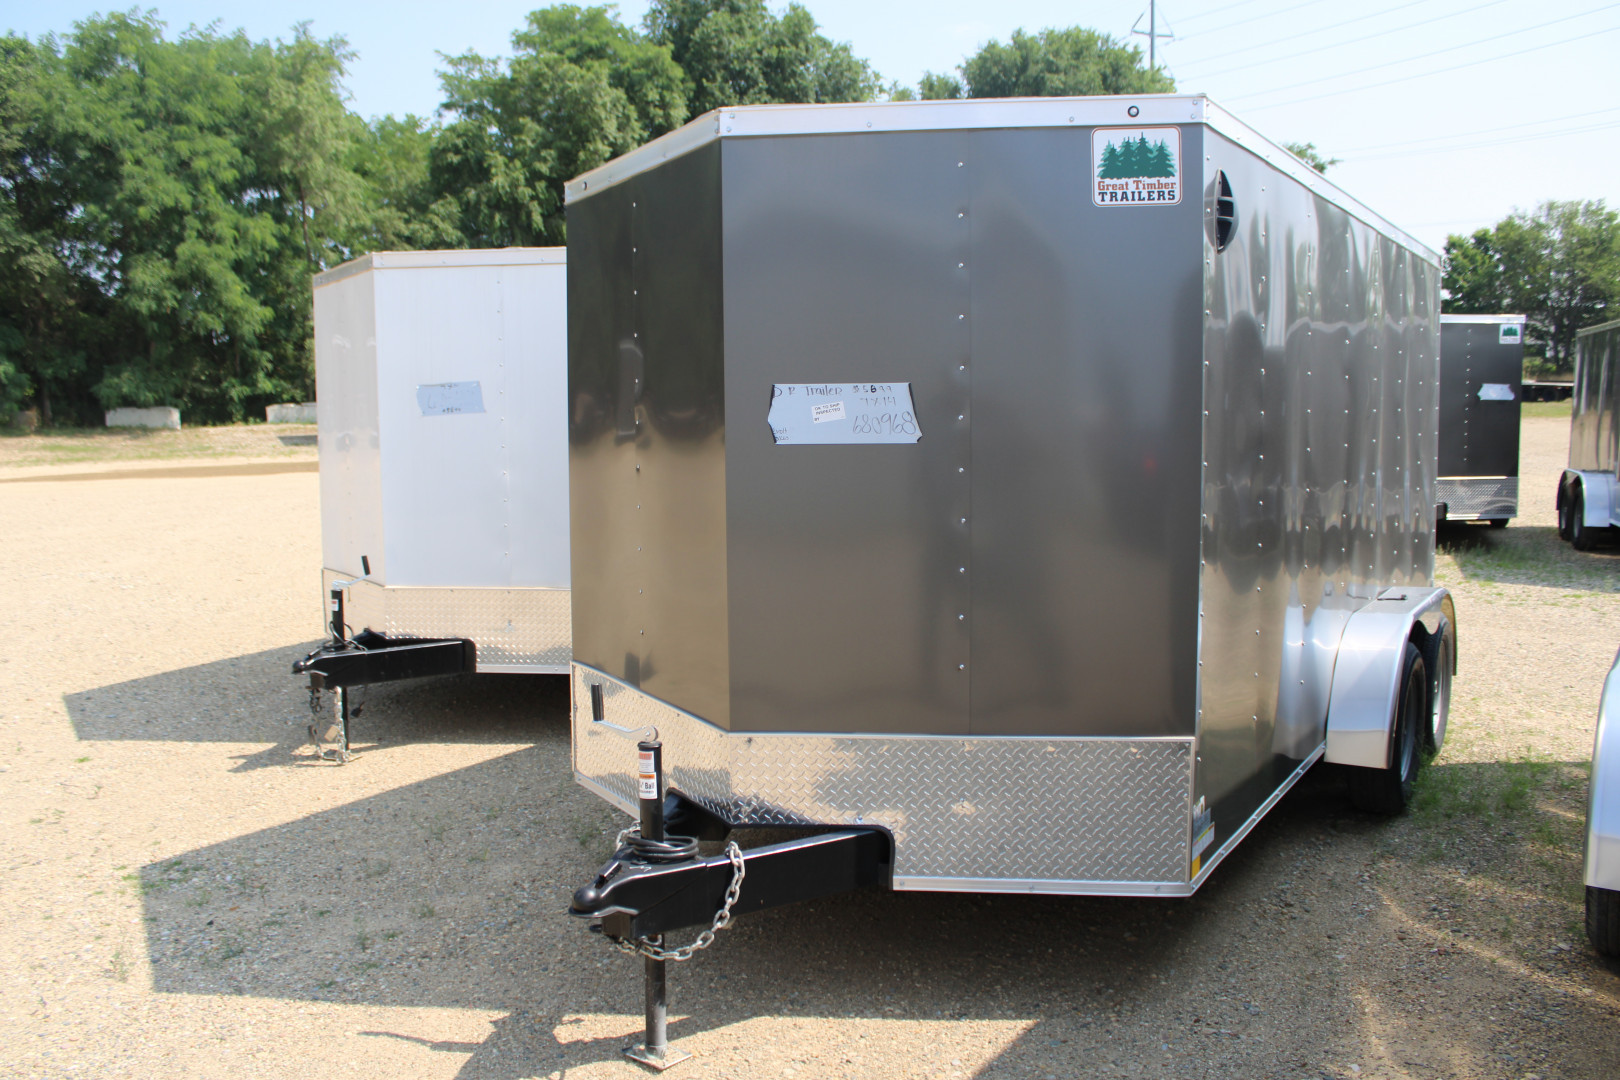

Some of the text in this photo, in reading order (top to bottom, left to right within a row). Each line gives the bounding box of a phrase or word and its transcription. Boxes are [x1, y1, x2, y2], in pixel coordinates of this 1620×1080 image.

[1098, 179, 1176, 191] Great Timber
[1098, 190, 1176, 202] TRAILERS
[853, 411, 916, 434] 680968
